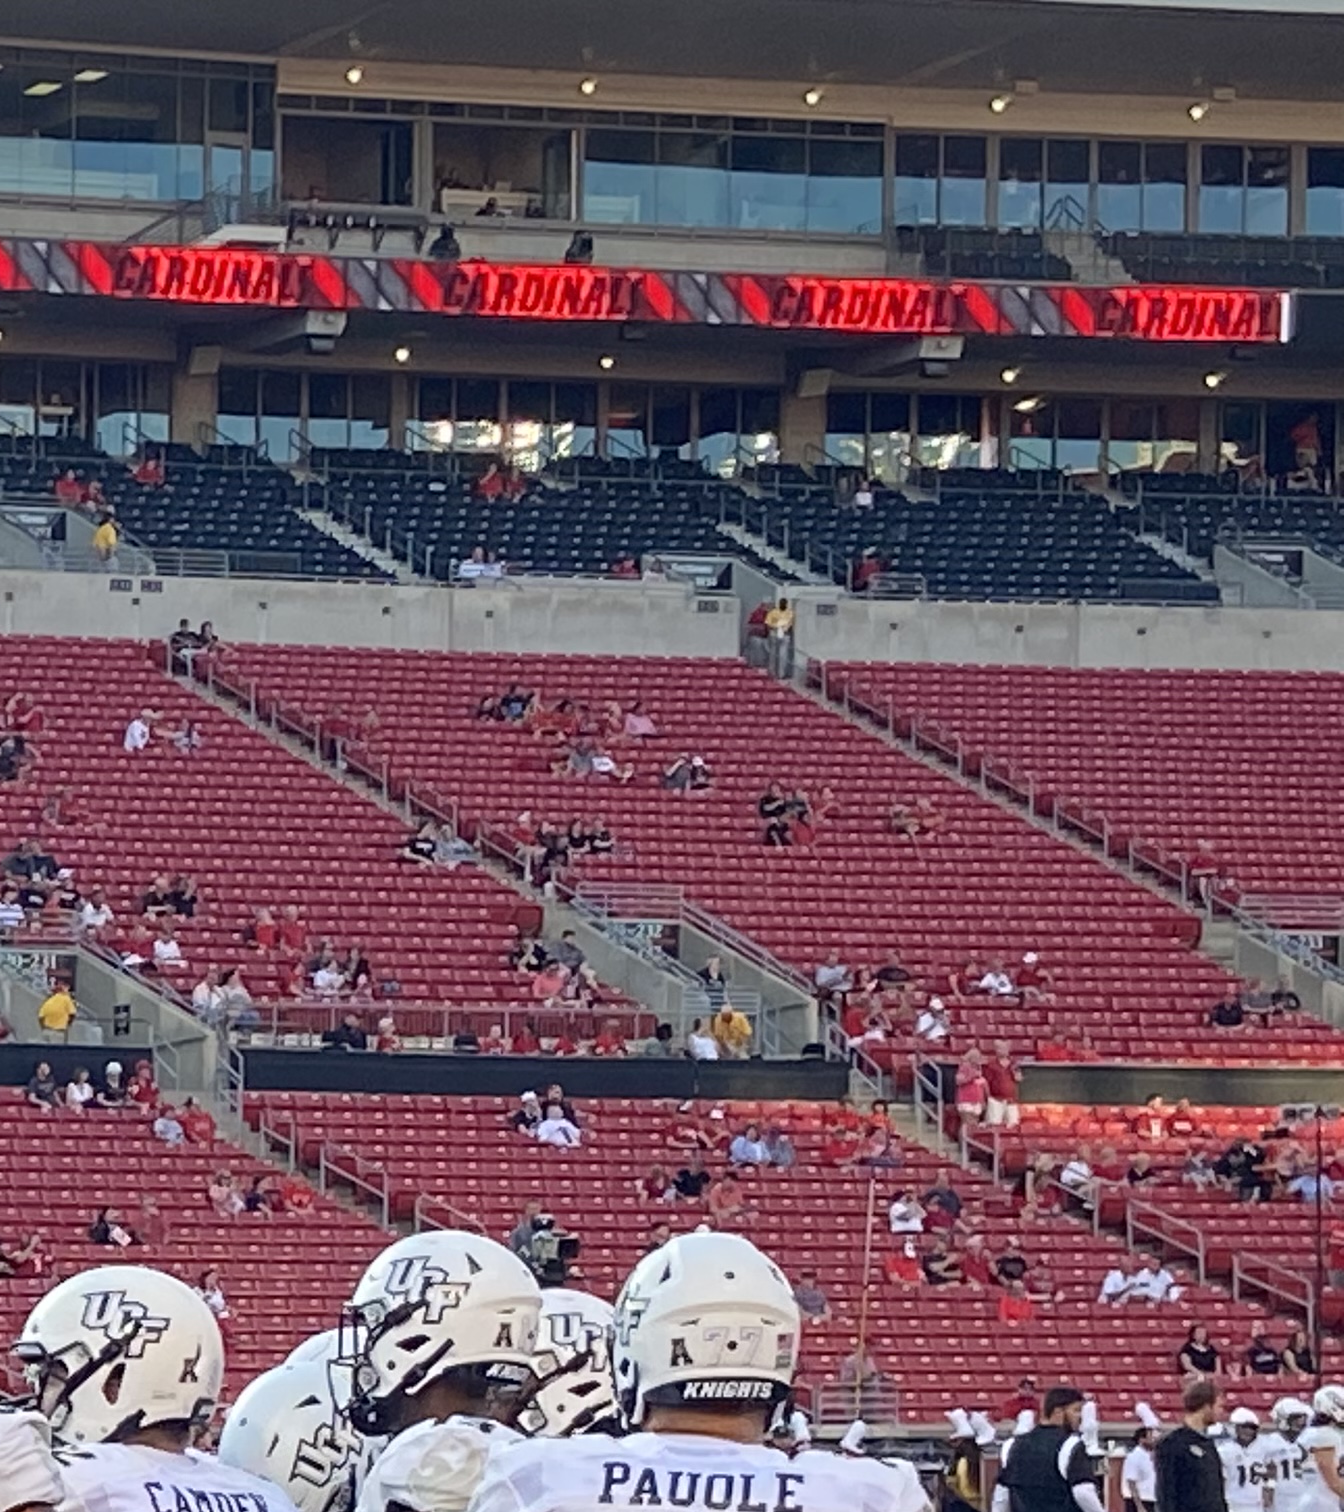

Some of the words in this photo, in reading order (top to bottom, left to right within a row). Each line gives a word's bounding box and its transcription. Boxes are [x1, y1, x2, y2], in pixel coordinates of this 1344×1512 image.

[384, 1256, 472, 1325] UCF
[82, 1290, 171, 1359] UCF
[702, 1326, 764, 1369] 77
[683, 1382, 774, 1400] KNIGHTS
